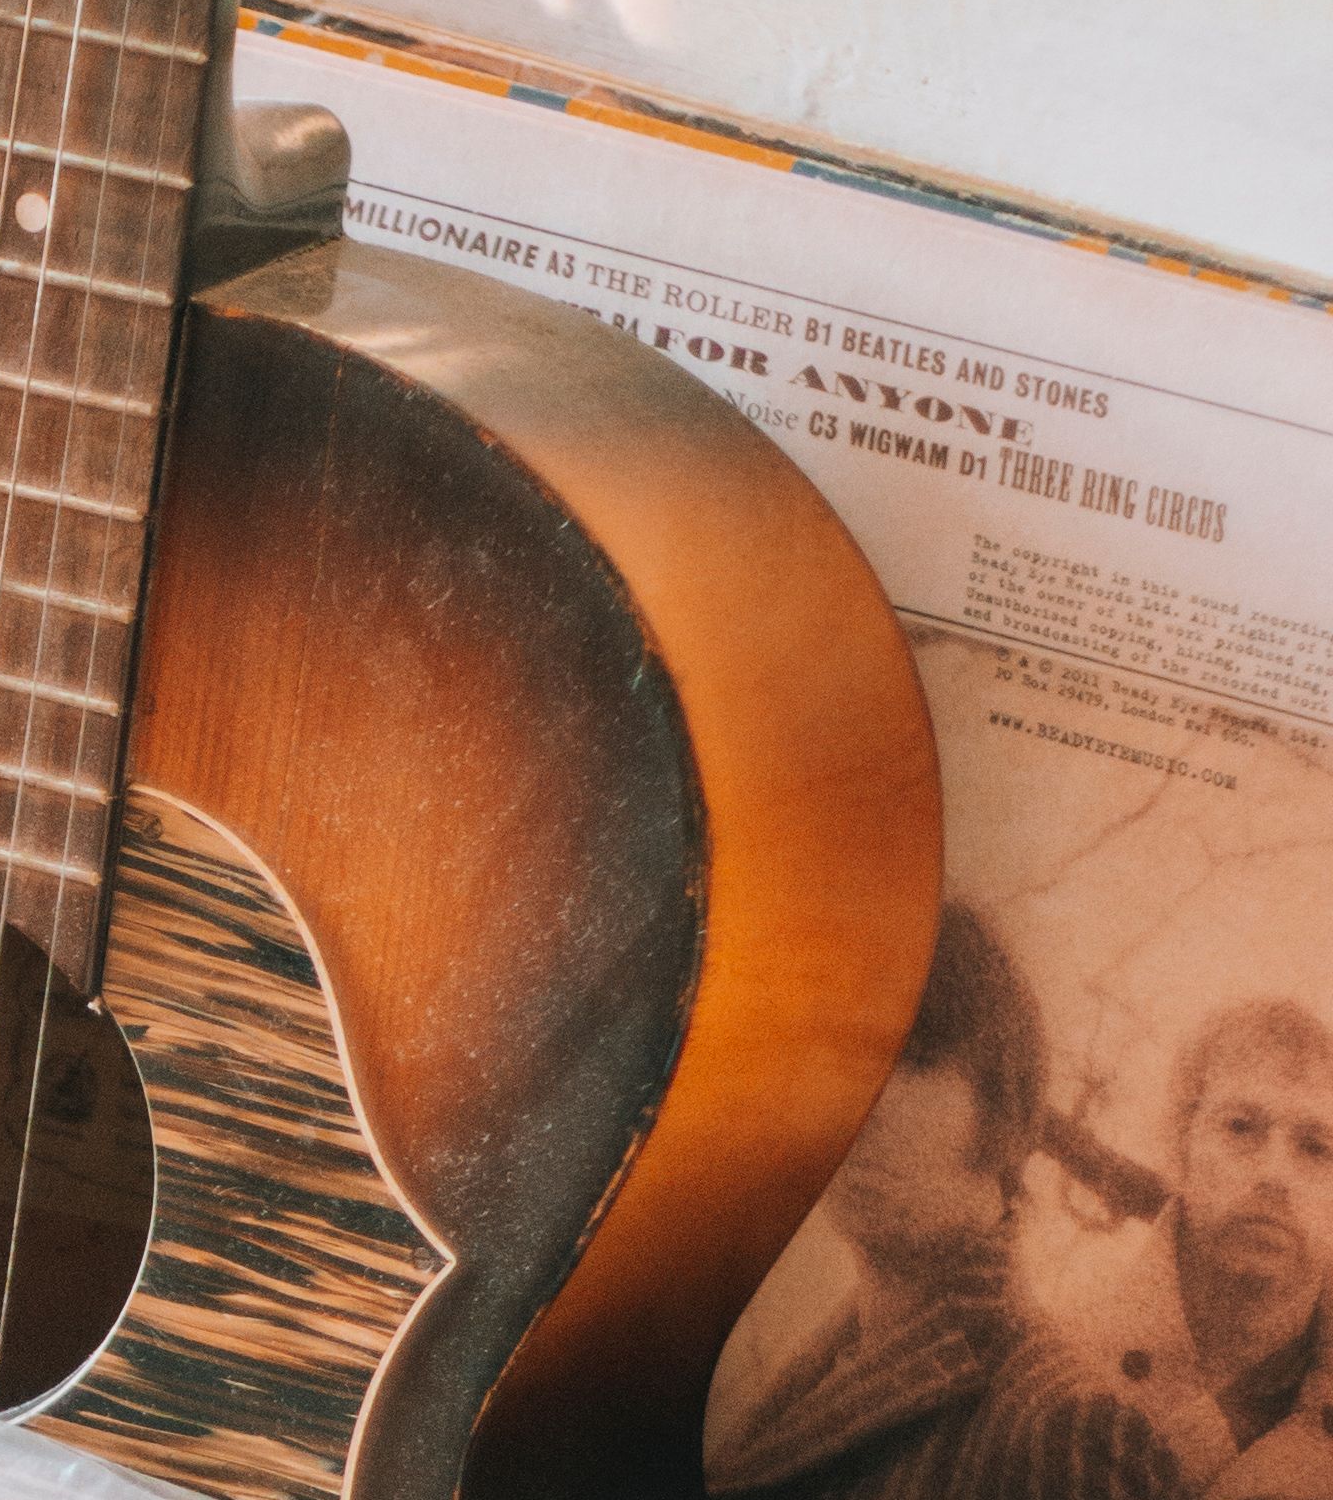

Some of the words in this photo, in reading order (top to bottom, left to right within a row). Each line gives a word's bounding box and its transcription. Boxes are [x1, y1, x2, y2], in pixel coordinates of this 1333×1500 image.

[343, 197, 540, 269] MILLIONAIRE
[546, 250, 575, 279] A3
[586, 262, 651, 299] THE
[664, 283, 793, 336] ROLLER
[805, 317, 831, 346] B1
[842, 327, 946, 376] BEATLES
[956, 356, 1004, 391] AND
[1015, 373, 1109, 419] STONES
[653, 326, 769, 377] FOR
[789, 364, 1033, 447] ANYONE
[808, 410, 838, 440] C3
[849, 421, 948, 470] WIGWAM
[959, 452, 988, 479] D1
[999, 446, 1073, 503] THREE
[1080, 469, 1138, 520] RING
[1145, 485, 1228, 543] CIRCUS
[973, 531, 1000, 553] The
[1013, 546, 1098, 579] copyright
[1065, 574, 1133, 608] Records
[1002, 612, 1120, 661] broadcasting
